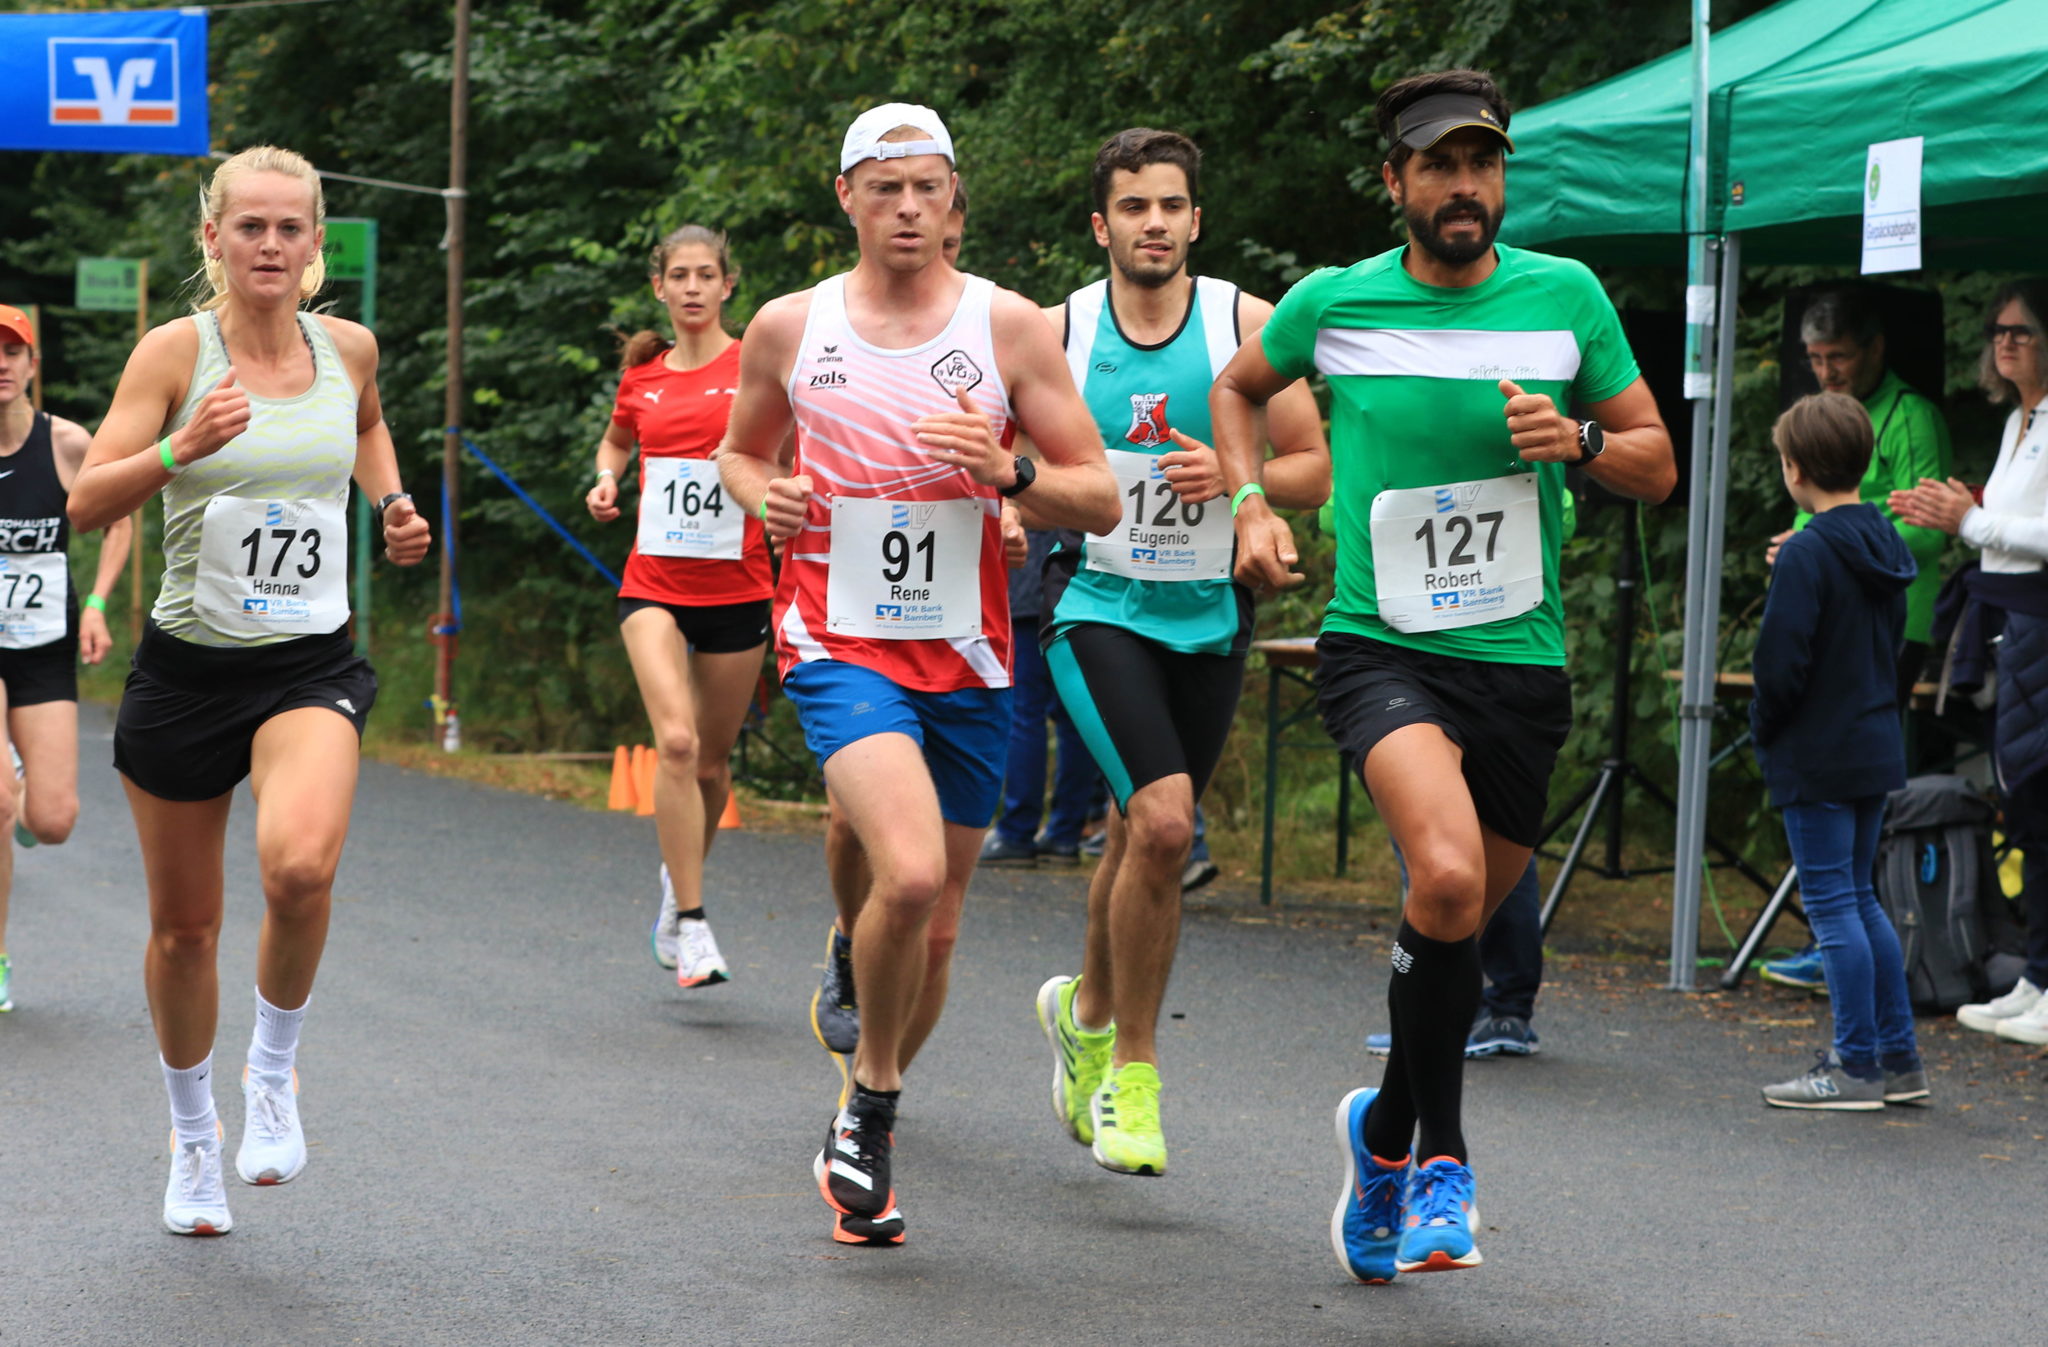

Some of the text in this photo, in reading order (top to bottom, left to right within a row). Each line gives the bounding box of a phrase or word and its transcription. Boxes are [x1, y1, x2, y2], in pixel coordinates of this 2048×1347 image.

[664, 480, 724, 518] 164
[680, 518, 699, 530] Lea
[1129, 528, 1190, 548] Eugenio
[1415, 511, 1504, 569] 127
[241, 528, 321, 579] 173
[882, 531, 935, 583] 91
[253, 579, 300, 595] Hanna
[1425, 569, 1483, 590] Robert
[3, 574, 43, 609] 72
[891, 585, 930, 601] Rene
[904, 614, 944, 623] Bamberg
[920, 604, 943, 613] Bank
